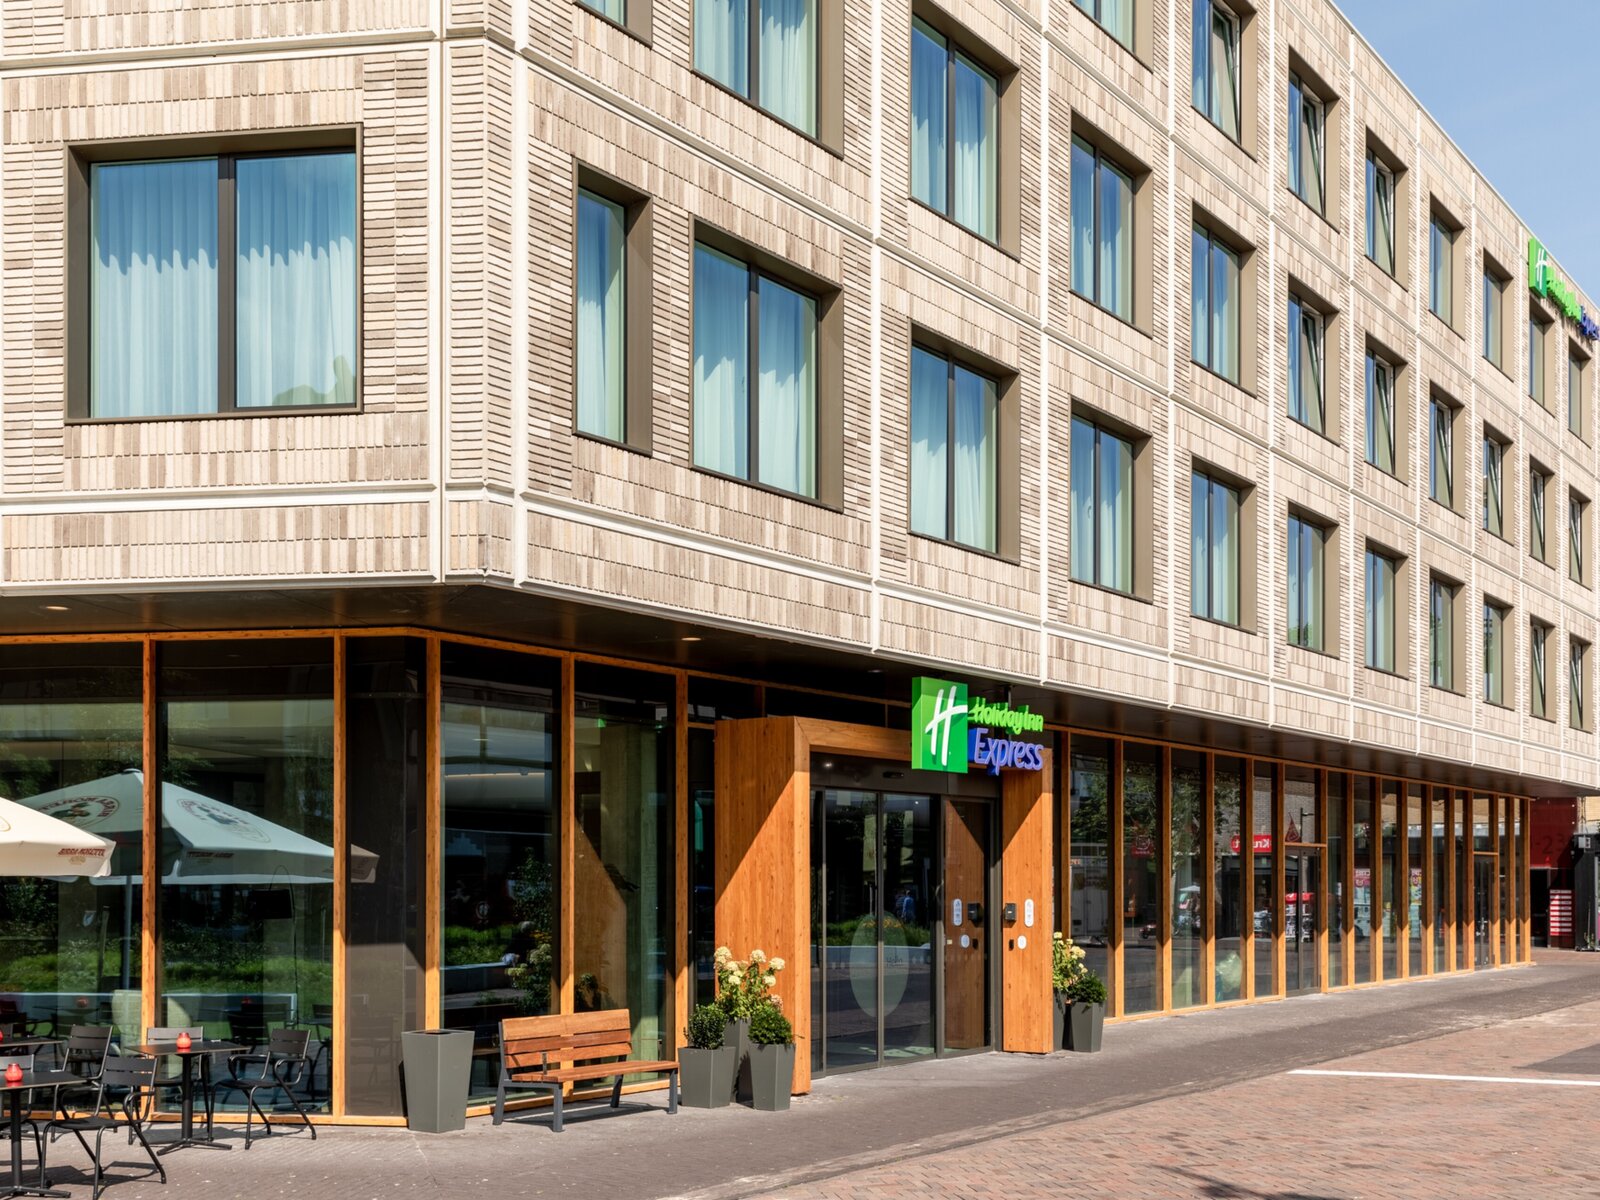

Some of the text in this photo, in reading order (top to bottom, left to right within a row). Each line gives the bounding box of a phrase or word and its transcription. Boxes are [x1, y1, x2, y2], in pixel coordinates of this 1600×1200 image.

[968, 697, 1044, 734] Holiday Inn
[974, 727, 1044, 776] Express
